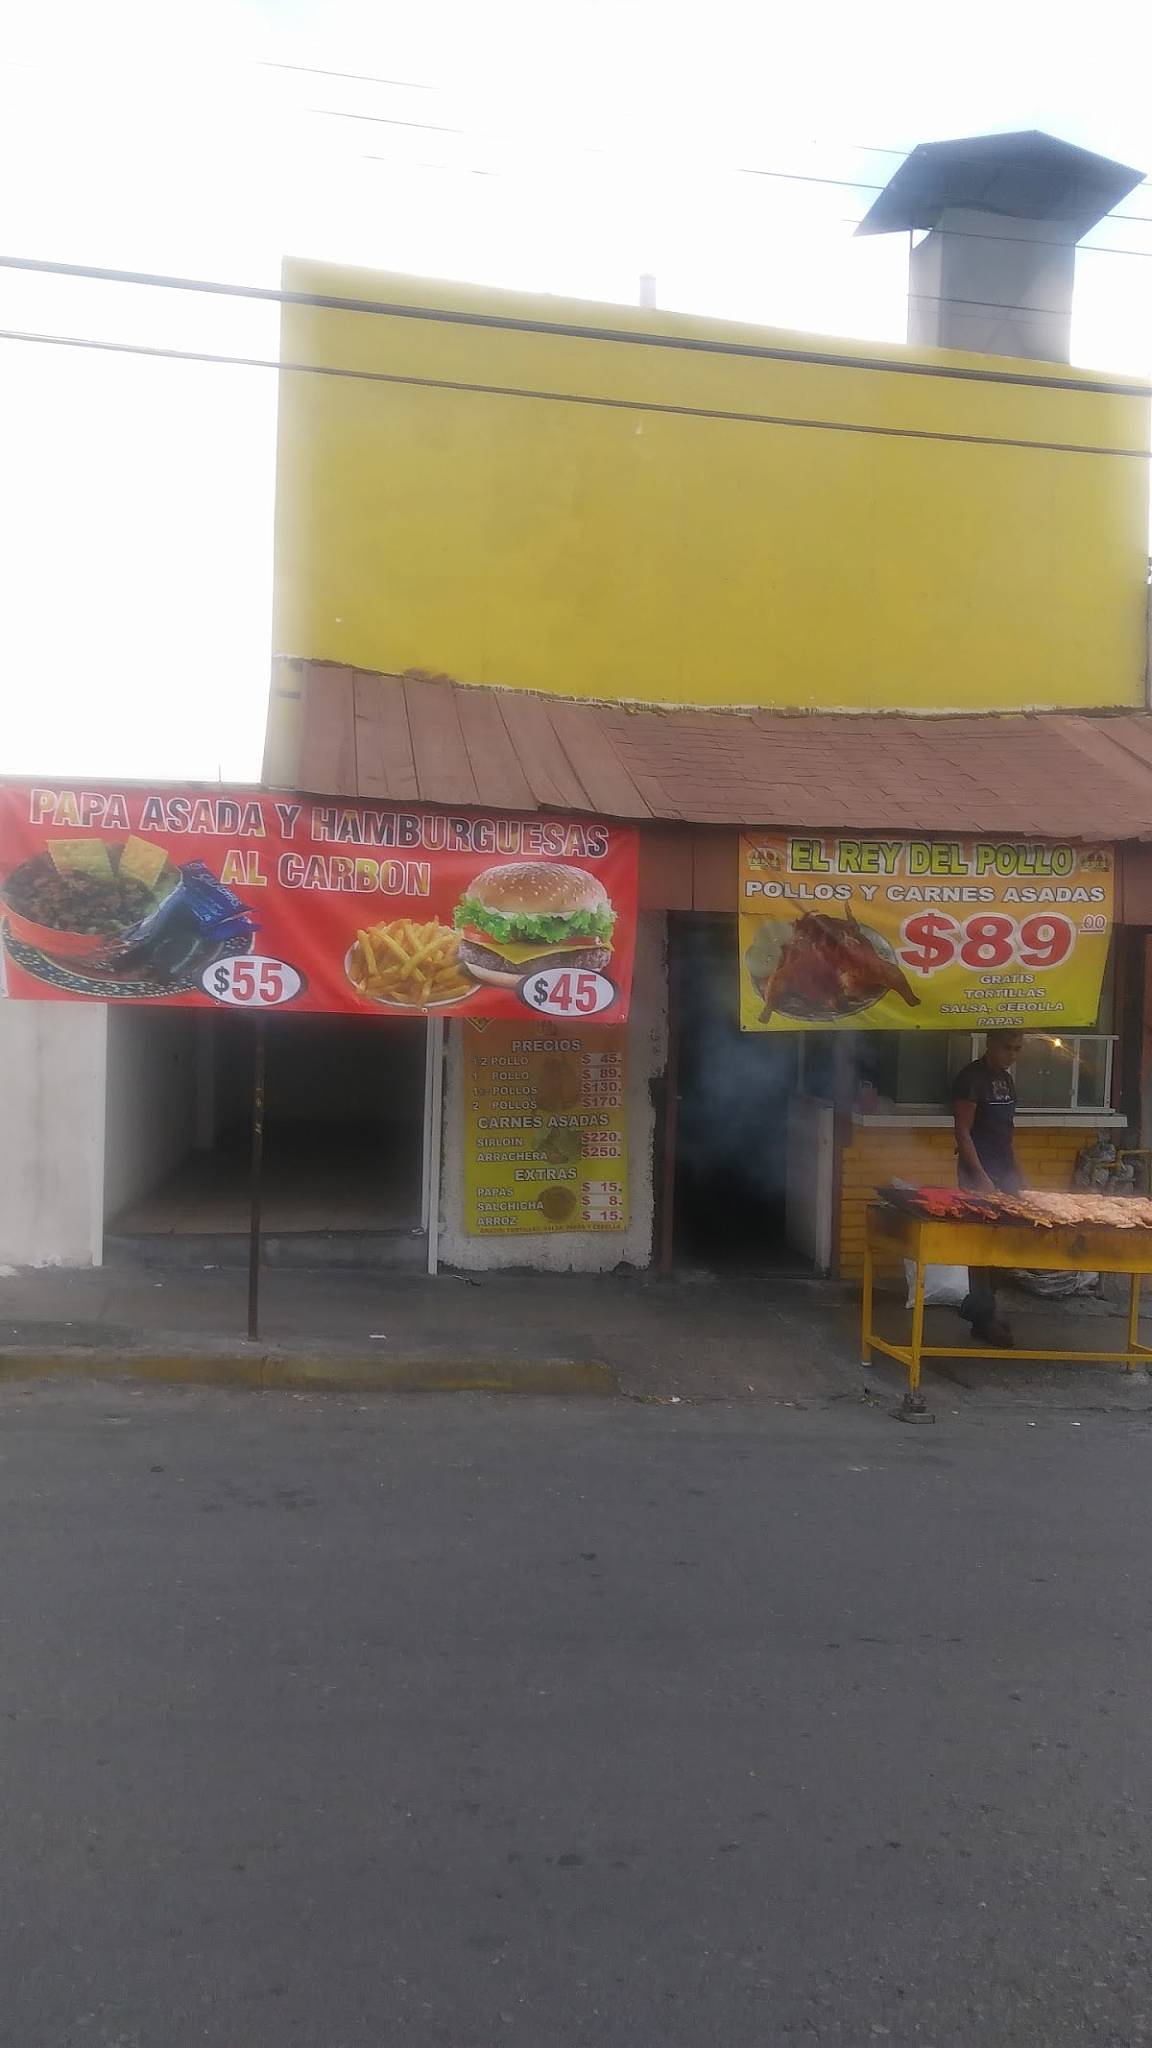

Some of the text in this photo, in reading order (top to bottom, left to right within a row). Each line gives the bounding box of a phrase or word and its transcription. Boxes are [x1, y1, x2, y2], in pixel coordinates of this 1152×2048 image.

[29, 789, 609, 859] PAPA ASADA Y HAMBURGUESAS
[788, 838, 1075, 878] EL REY DEL POLLO
[221, 850, 267, 887] AL
[277, 853, 431, 897] CARBON
[745, 881, 1105, 903] POLLOS Y CARNES ASADAS
[898, 909, 1076, 977] $89
[213, 961, 284, 1002] $55
[979, 974, 1034, 985] GRATIS
[533, 973, 598, 1013] $45
[964, 988, 1045, 999] TORTILLAS
[997, 1002, 1064, 1012] CEBOLLA
[976, 1016, 1023, 1027] PAPAS
[511, 1040, 581, 1052] PRECIOS
[490, 1056, 529, 1066] POLLO
[491, 1071, 529, 1081] POLLO
[492, 1086, 538, 1096] POLLOS
[472, 1100, 480, 1110] 2
[492, 1100, 538, 1110] POLLOS
[478, 1114, 609, 1129] CARNES ASADAS
[477, 1137, 523, 1147] SIRLOIN
[477, 1151, 548, 1162] ARRACHERA
[514, 1168, 577, 1181] EXTRAS
[477, 1187, 514, 1197] PAPAS
[477, 1200, 544, 1211] SALCHICHA
[477, 1216, 517, 1226] ARROZ
